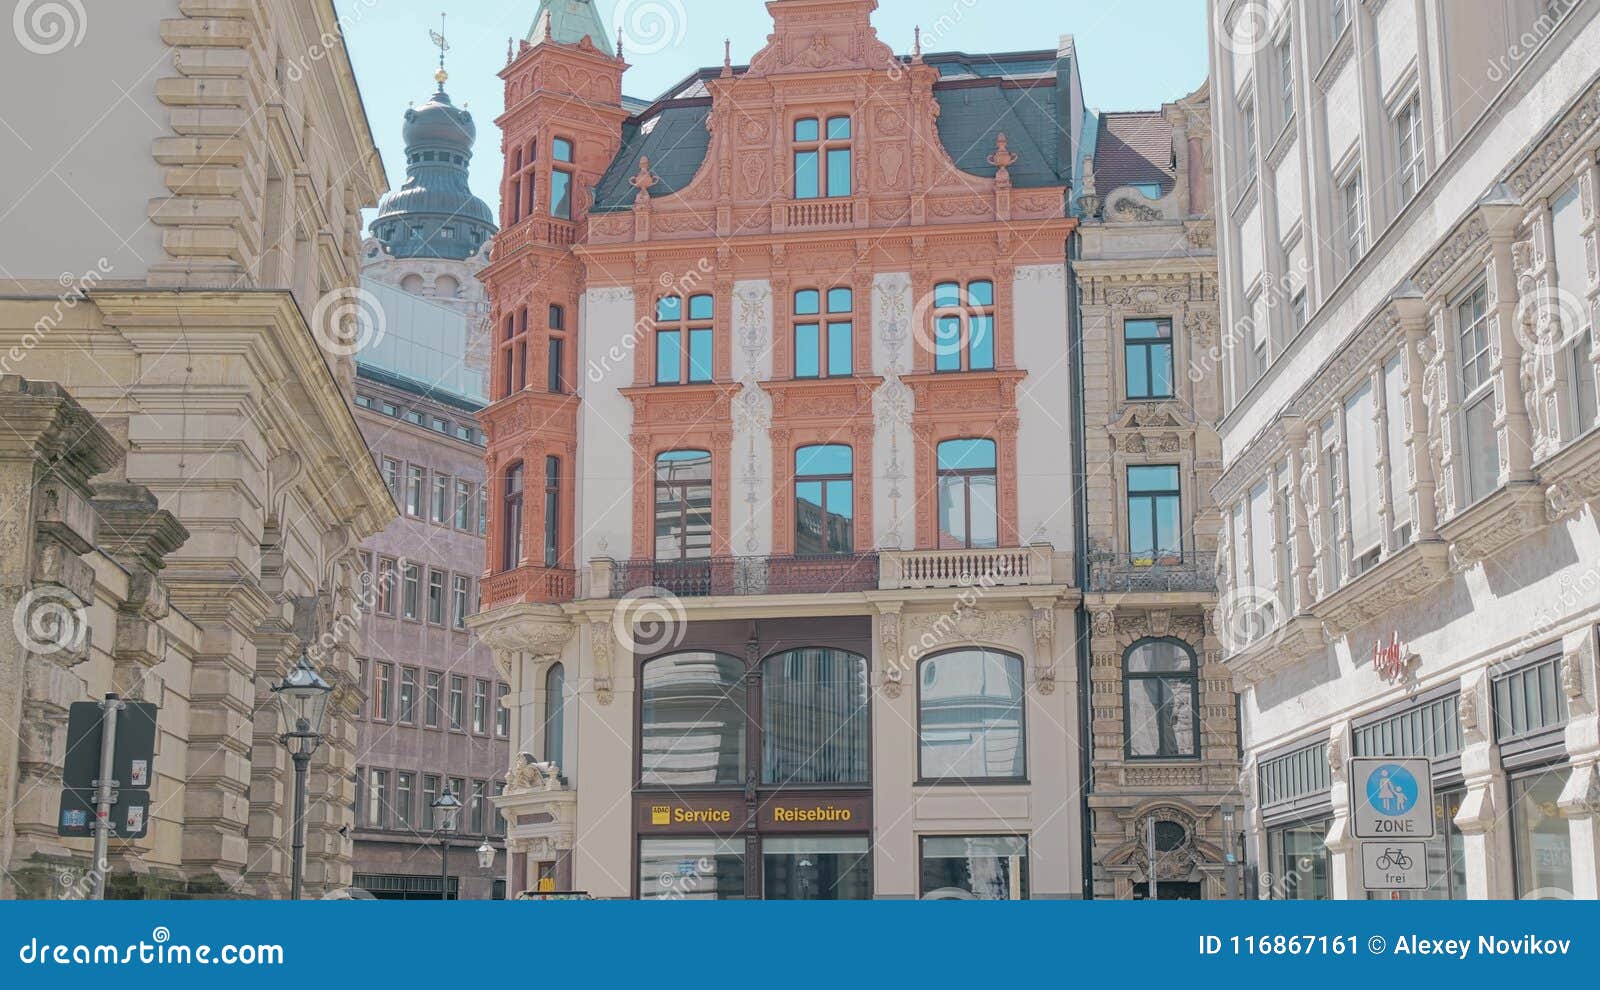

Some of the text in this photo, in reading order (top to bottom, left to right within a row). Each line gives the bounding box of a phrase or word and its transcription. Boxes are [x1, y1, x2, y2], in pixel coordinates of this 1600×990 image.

[674, 807, 730, 822] Service
[774, 806, 851, 821] Reisebüro
[1375, 819, 1414, 832] ZONE
[1385, 873, 1406, 883] frei
